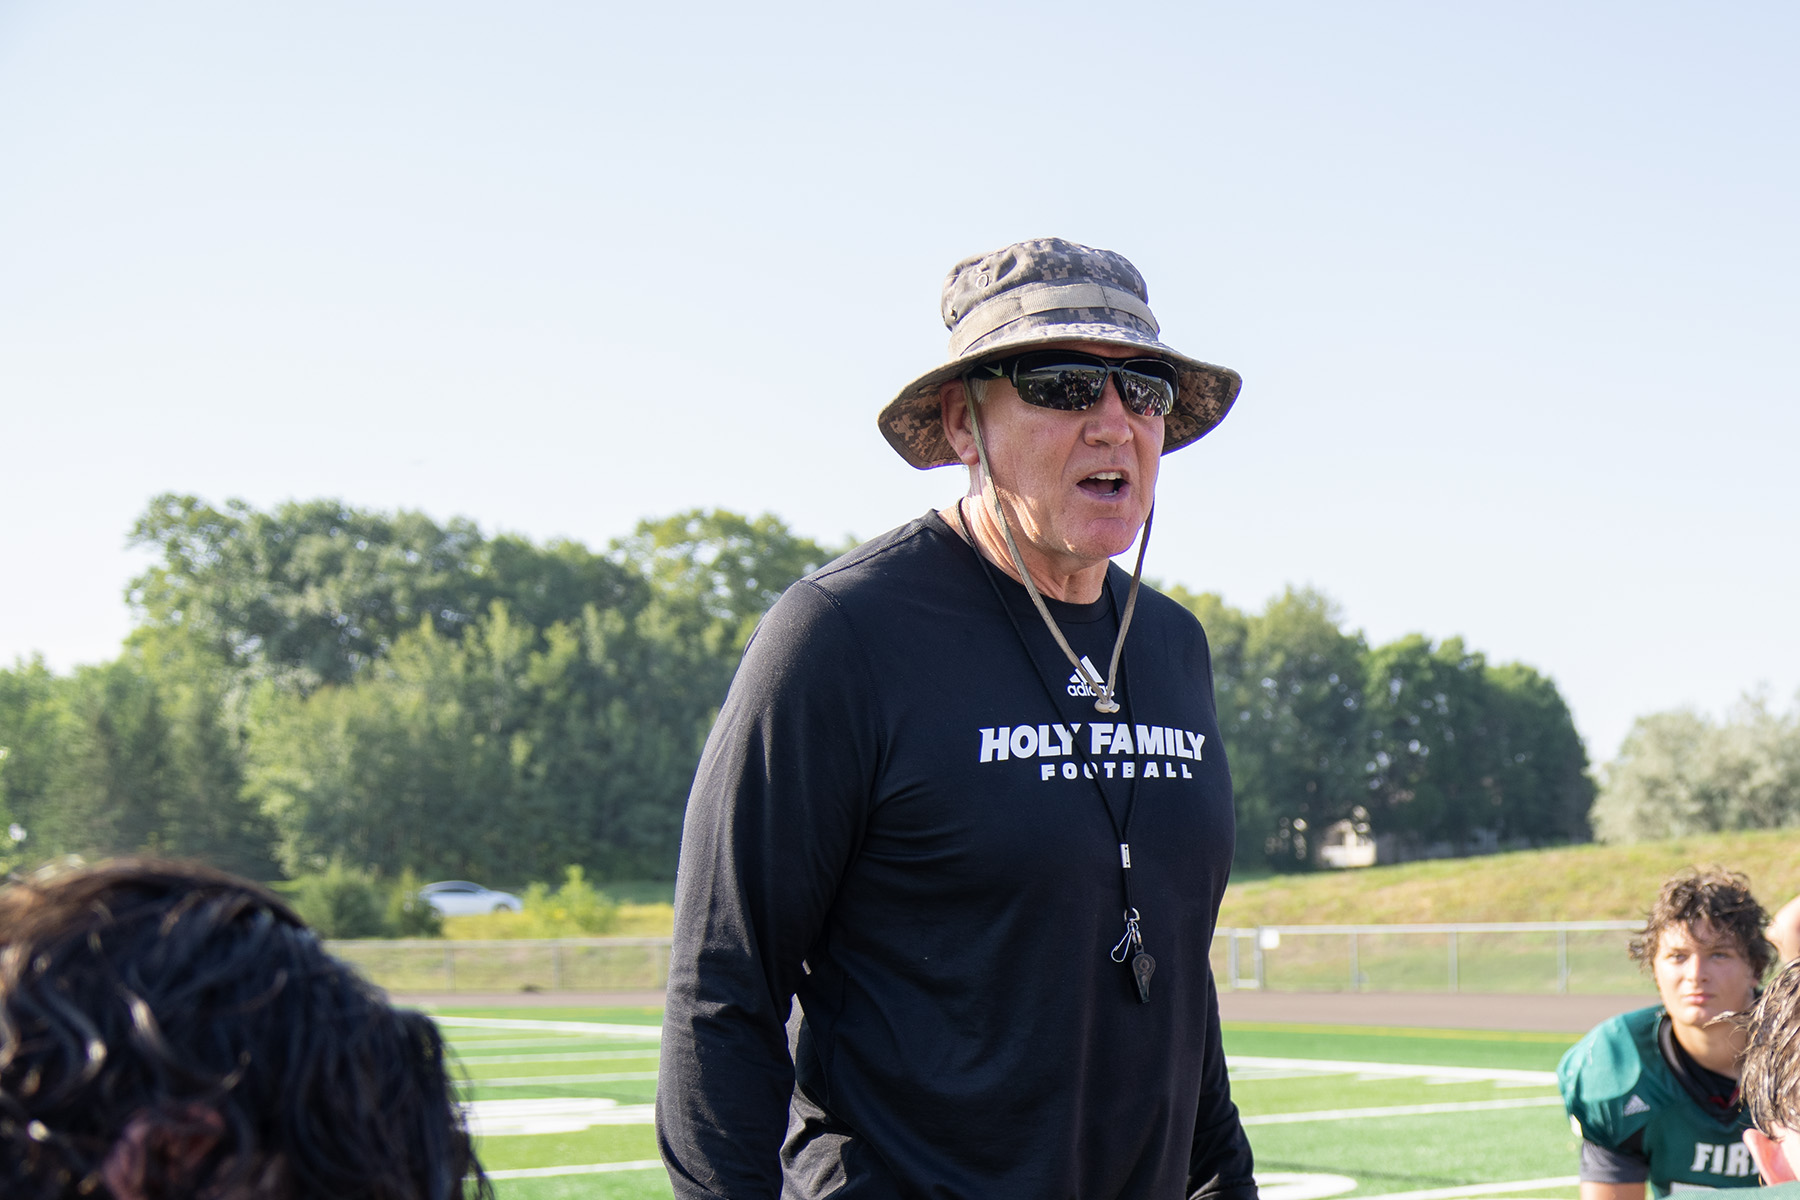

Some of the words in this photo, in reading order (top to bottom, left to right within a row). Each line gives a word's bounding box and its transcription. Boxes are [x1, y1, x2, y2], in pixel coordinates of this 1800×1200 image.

[978, 723, 1082, 763] HOLY
[1088, 722, 1206, 762] FAMILY
[1040, 760, 1194, 782] FOOTBALL
